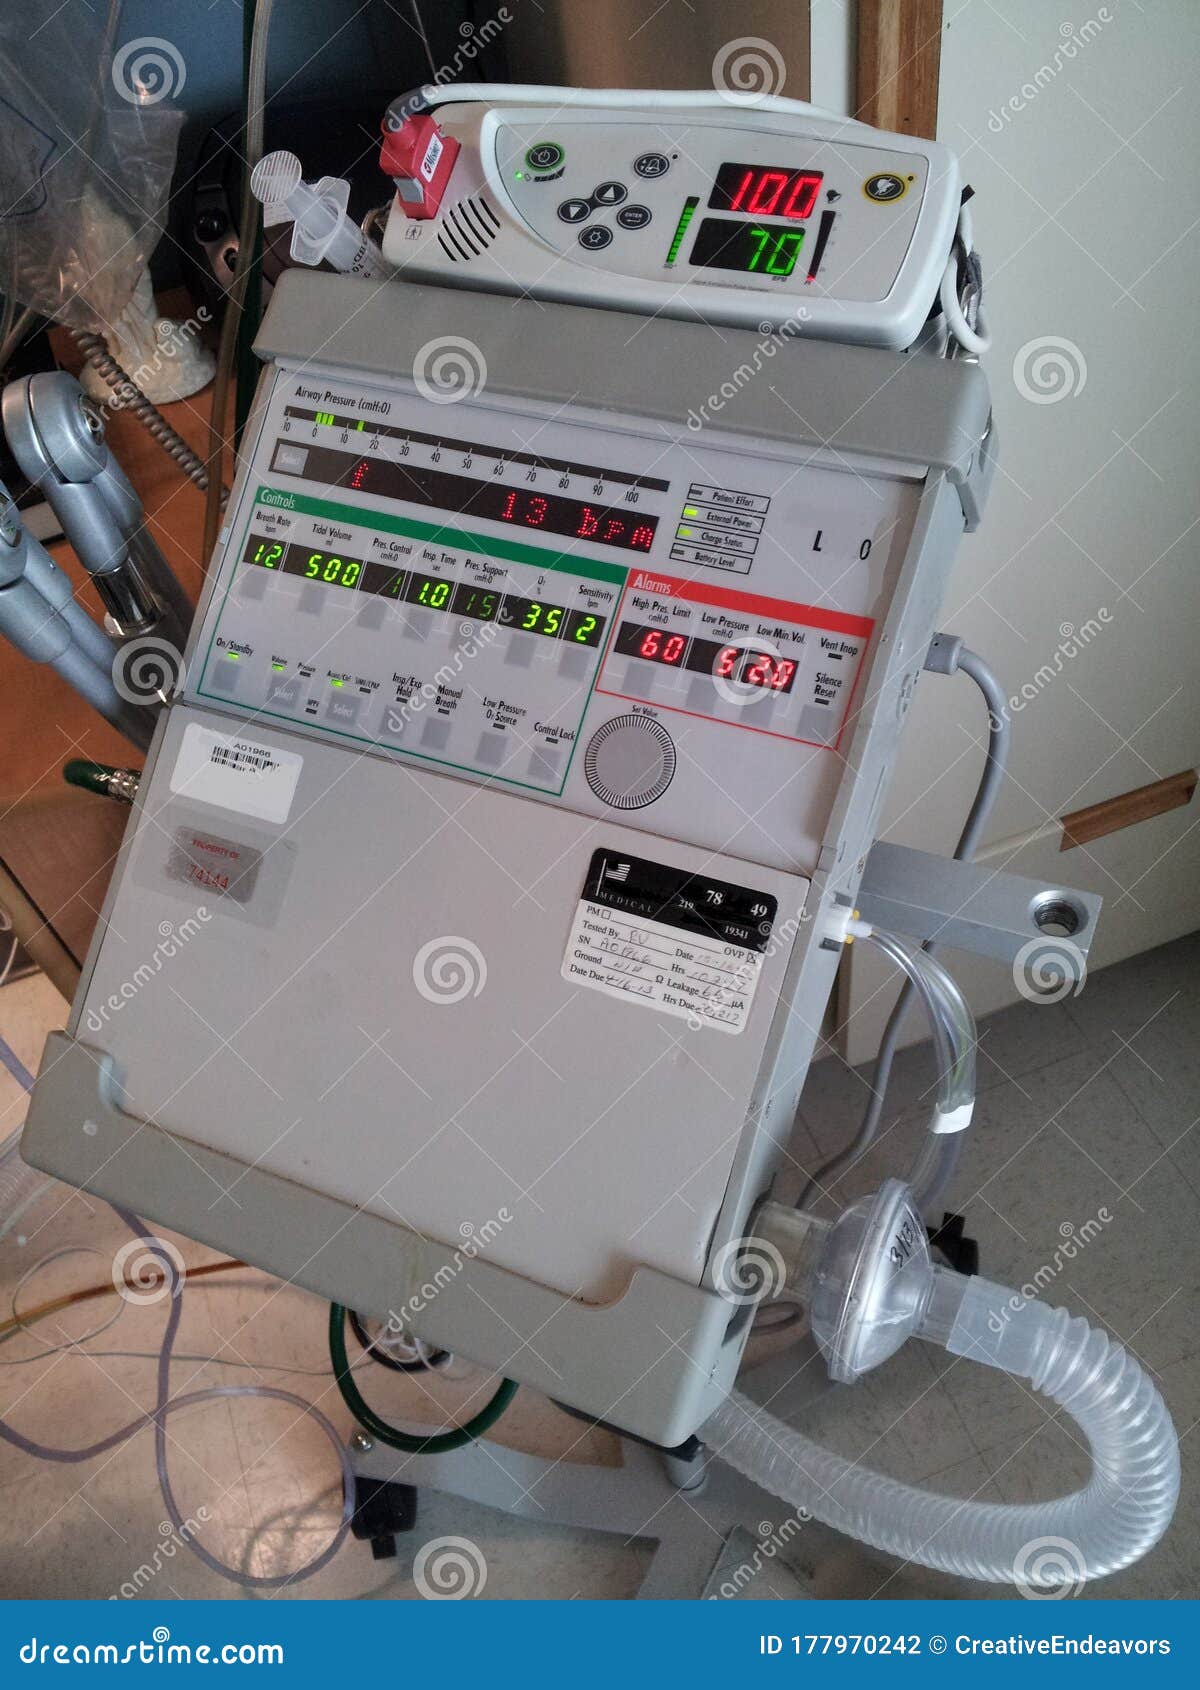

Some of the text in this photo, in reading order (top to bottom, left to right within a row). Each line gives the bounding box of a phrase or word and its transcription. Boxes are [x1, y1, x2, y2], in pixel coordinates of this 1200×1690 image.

[732, 171, 822, 219] 100
[748, 230, 803, 275] 70
[295, 386, 323, 402] Airway
[324, 391, 357, 408] Pressure
[312, 427, 318, 438] 0
[340, 432, 349, 444] 10
[369, 438, 380, 450] 20
[399, 445, 410, 457] 30
[430, 452, 441, 463] 40
[461, 458, 473, 470] 50
[493, 464, 504, 476] 60
[525, 470, 537, 483] 70
[558, 477, 570, 489] 80
[592, 483, 603, 496] 90
[624, 490, 639, 503] 100
[260, 488, 296, 509] Controls
[713, 491, 755, 508] Patient Effort
[501, 492, 549, 524] 13
[256, 511, 292, 528] Breath Rate
[706, 511, 753, 528] External Power
[312, 523, 353, 542] Tidal Volume
[701, 531, 744, 549] Charge Status
[812, 530, 822, 552] L
[389, 541, 413, 556] Control
[440, 553, 457, 567] Time
[694, 551, 736, 568] Battery Level
[481, 563, 509, 579] Support
[632, 573, 672, 594] Alarms
[253, 544, 283, 568] 12
[305, 554, 360, 587] 500
[418, 582, 449, 608] 1.0
[465, 593, 496, 618] 15
[522, 604, 562, 634] 35
[575, 617, 596, 641] 2
[578, 584, 614, 603] Sensitivity
[632, 597, 650, 611] High
[672, 605, 691, 618] Limit
[702, 612, 749, 632] Low Pressure
[757, 624, 773, 636] Low
[216, 637, 254, 657] On/Standby
[820, 637, 858, 657] Vent Inop
[271, 655, 288, 666] Volume
[640, 632, 795, 687] 60 5 2.0
[392, 672, 422, 689] Insp/Exp
[815, 673, 842, 688] Silence
[396, 686, 413, 698] Hold
[438, 684, 463, 699] Manual
[814, 685, 836, 699] Reset
[333, 704, 353, 718] Select
[435, 695, 458, 710] Breath
[483, 697, 527, 717] Low Pressure
[631, 704, 659, 718] Set Value
[495, 712, 518, 726] Source
[533, 722, 575, 741] Control Lock
[234, 743, 271, 758] A01966
[192, 839, 240, 861] PROPERTY OF
[190, 863, 229, 889] 74144
[600, 891, 652, 913] MEDICAL
[679, 899, 695, 910] 219
[706, 890, 724, 905] 78
[751, 903, 768, 917] 49
[582, 920, 620, 941] Tested By
[586, 905, 745, 959] PM OVP
[725, 925, 749, 939] 19341
[577, 935, 591, 946] SN
[574, 949, 603, 965] Ground
[675, 949, 694, 961] Date
[570, 965, 605, 983] Date Due
[671, 963, 686, 975] Hrs
[666, 978, 700, 996] Leakage
[662, 993, 696, 1011] Hrs Due
